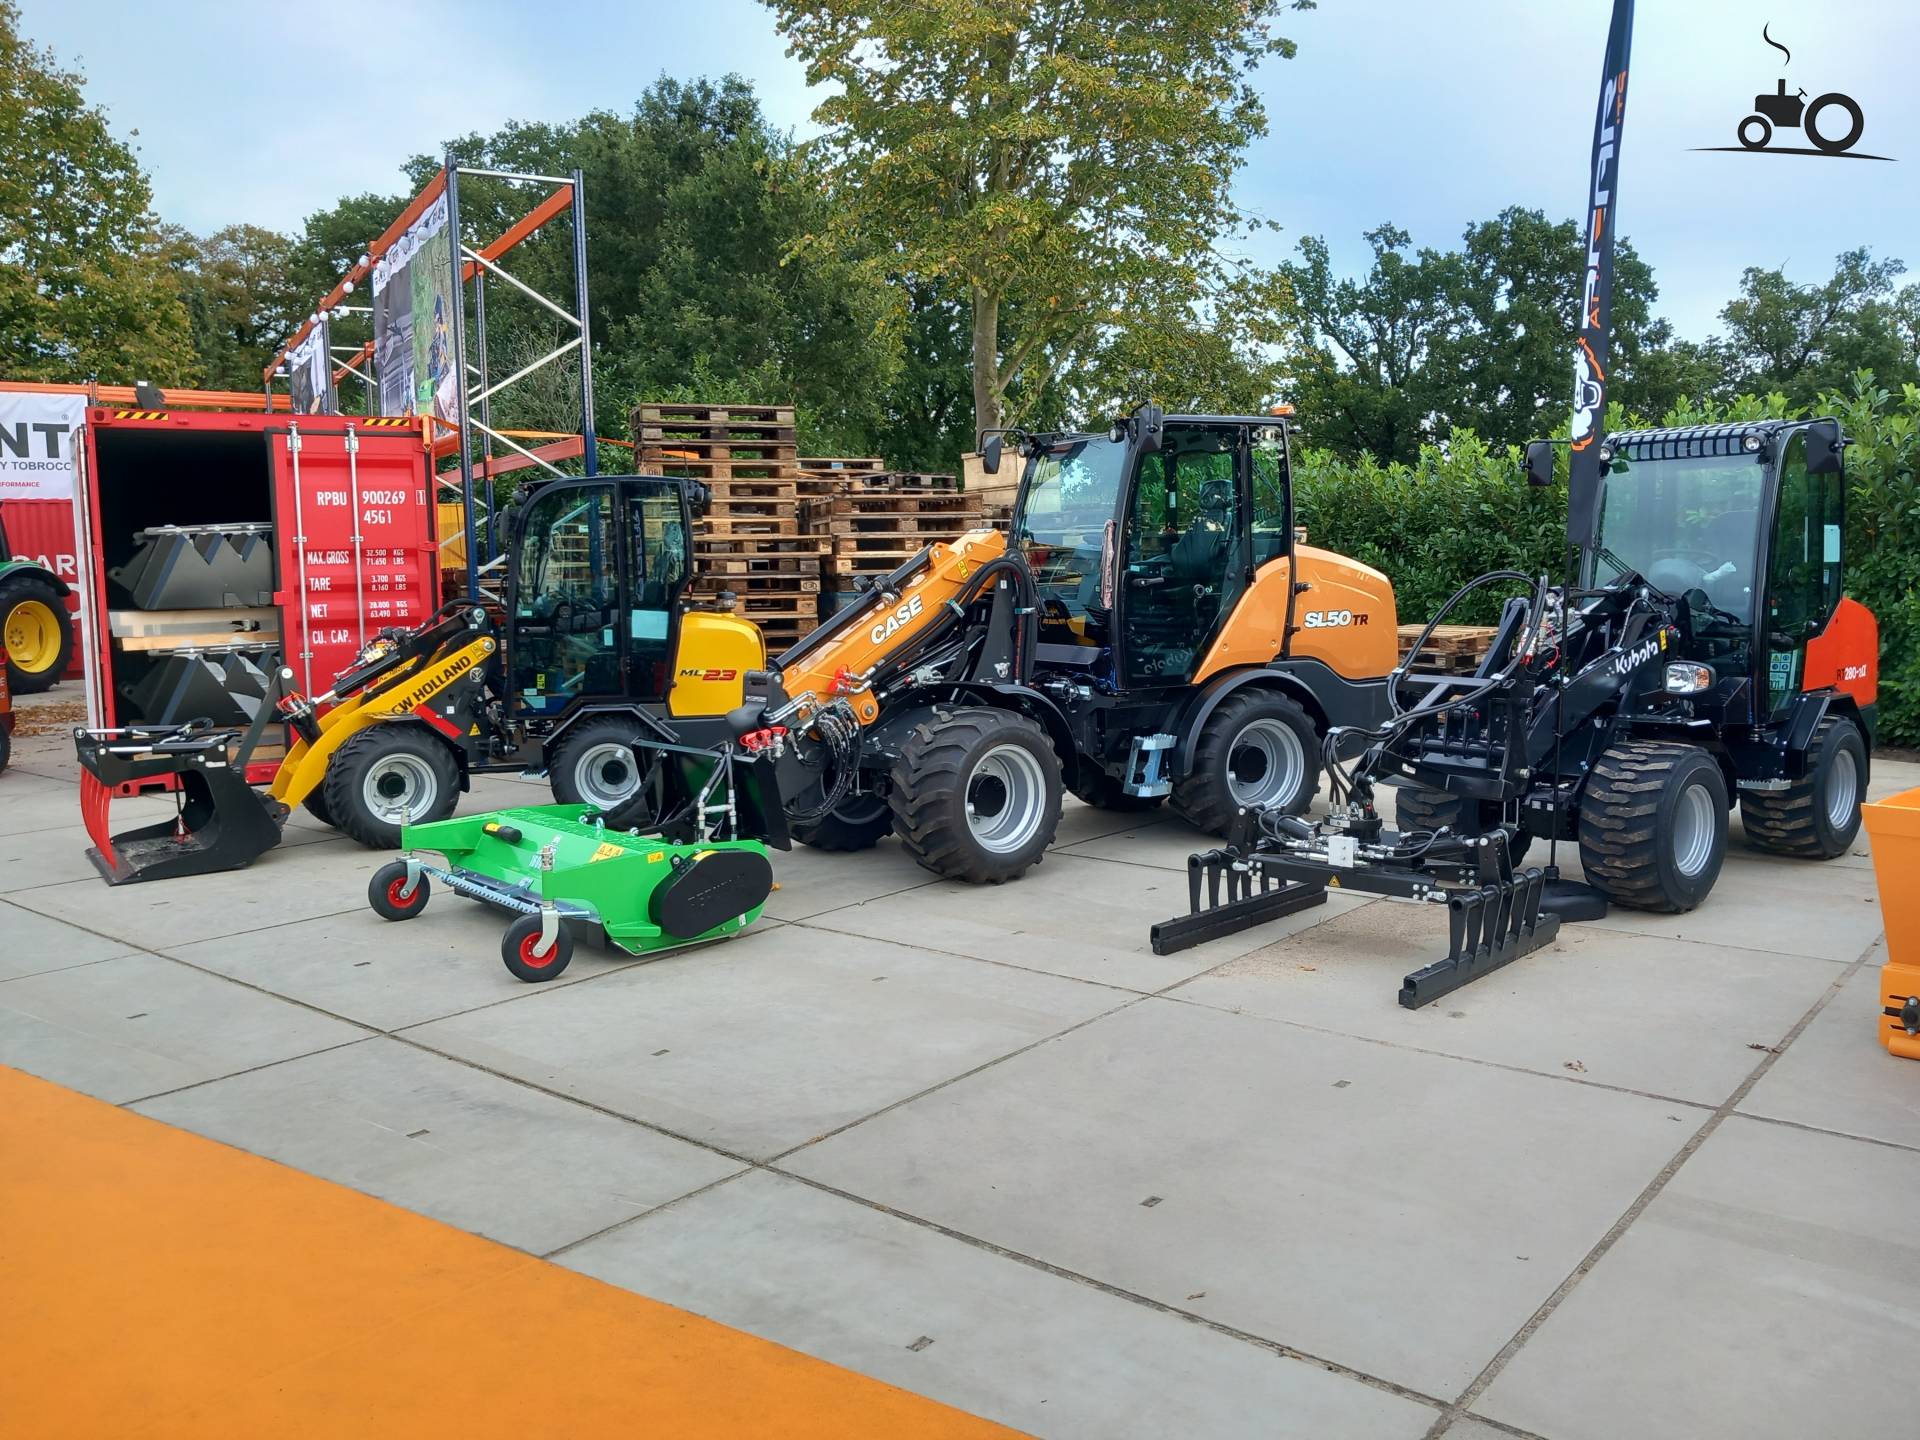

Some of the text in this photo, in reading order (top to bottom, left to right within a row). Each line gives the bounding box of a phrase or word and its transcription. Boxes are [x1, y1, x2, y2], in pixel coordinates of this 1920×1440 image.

[316, 491, 348, 506] RPBU
[362, 490, 406, 505] 900269
[363, 510, 393, 524] 45G1
[393, 557, 405, 565] LBS
[309, 577, 331, 591] TARE
[395, 583, 407, 591] LBS
[310, 604, 328, 617] NET
[397, 609, 408, 617] LBS
[870, 593, 924, 645] CASE
[1304, 609, 1369, 628] SL50 TR
[331, 629, 352, 643] CAP.
[1615, 640, 1659, 675] Kubota
[412, 655, 472, 702] HOLLAND
